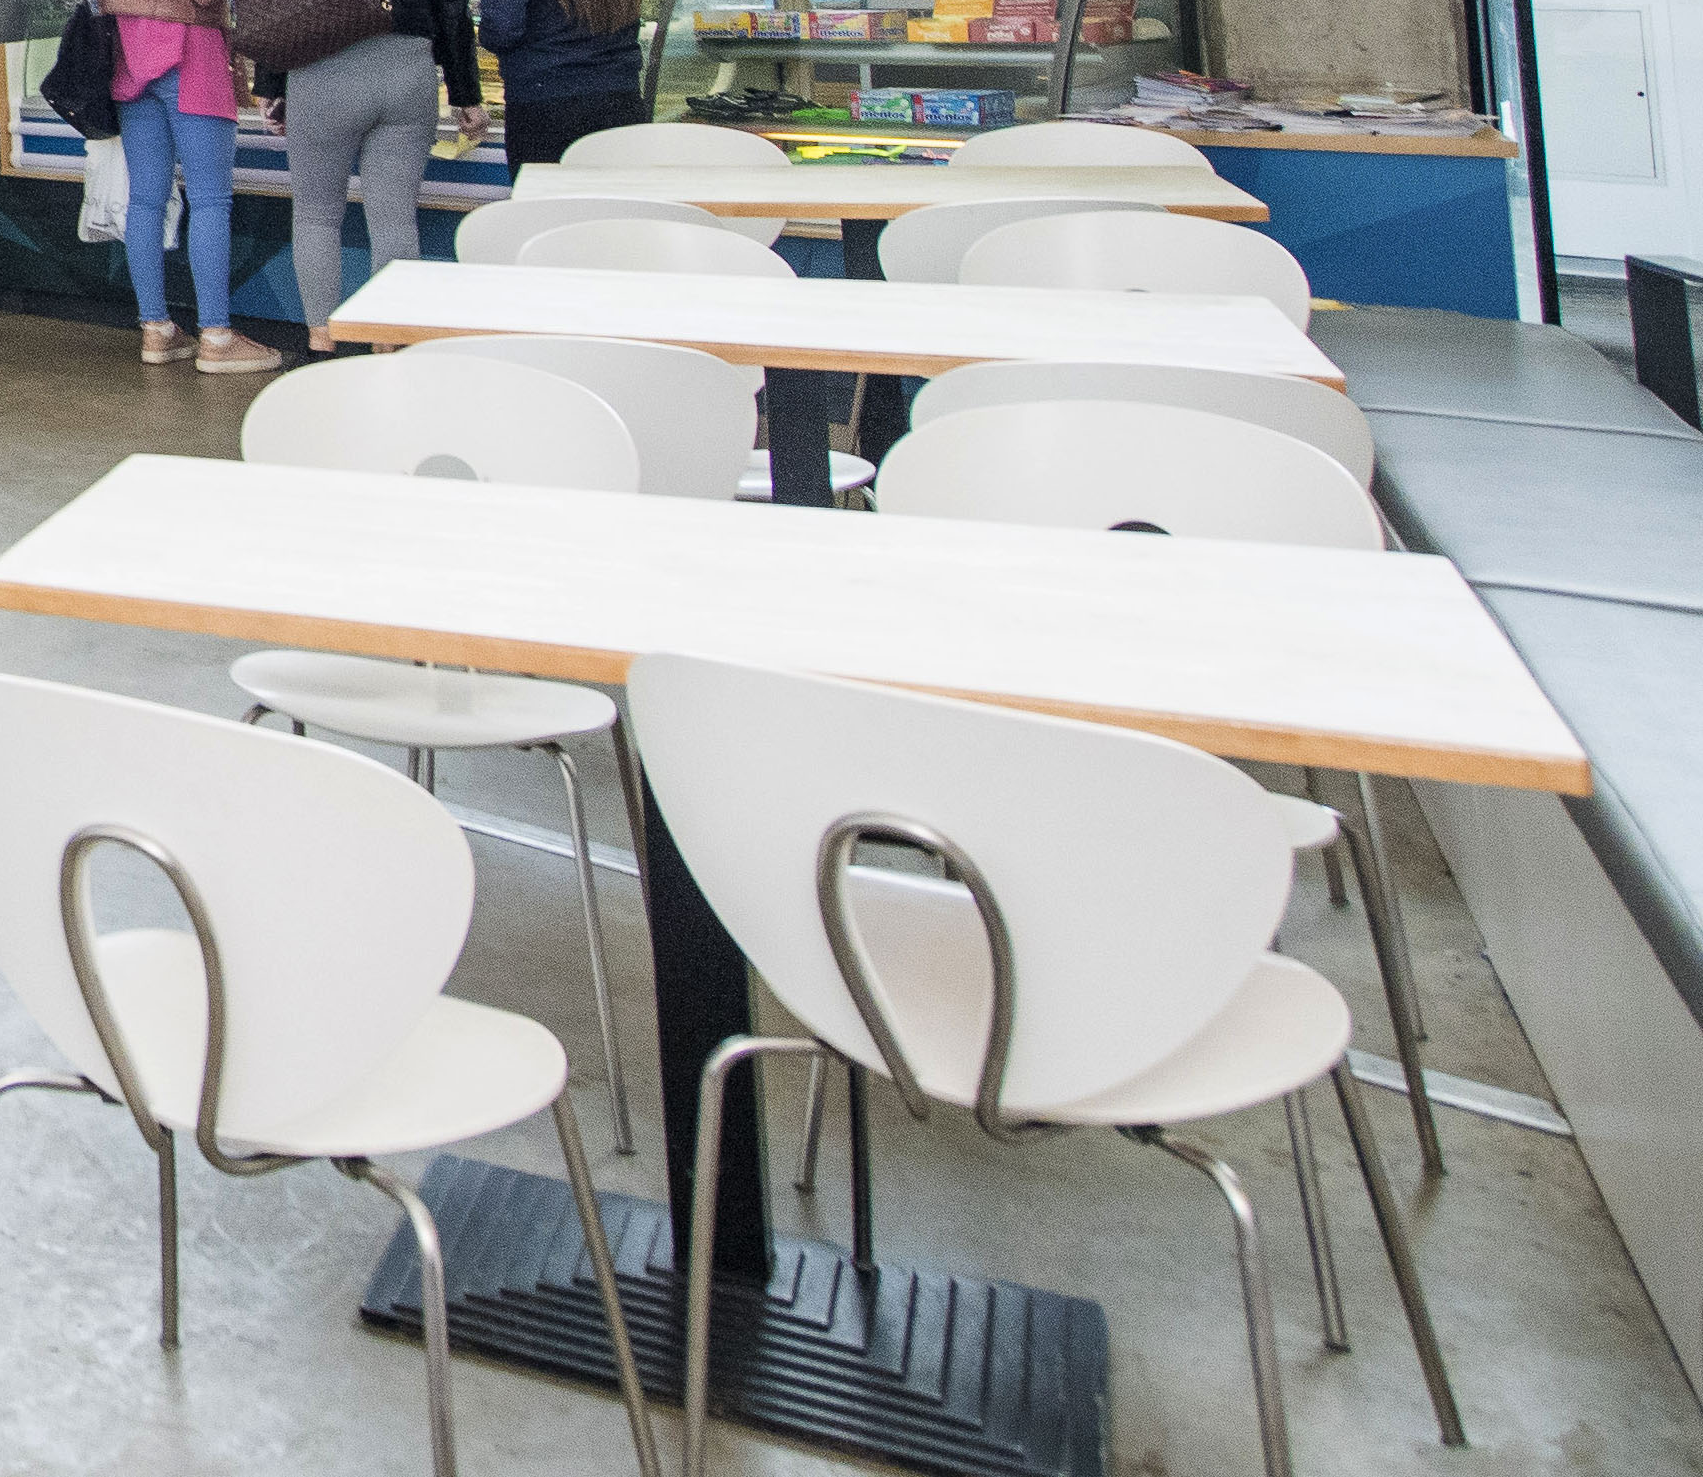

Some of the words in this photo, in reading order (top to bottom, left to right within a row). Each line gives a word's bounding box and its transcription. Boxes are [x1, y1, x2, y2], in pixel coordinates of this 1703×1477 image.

[819, 30, 864, 38] mentos
[861, 111, 906, 119] mentos
[925, 113, 972, 121] mentos
